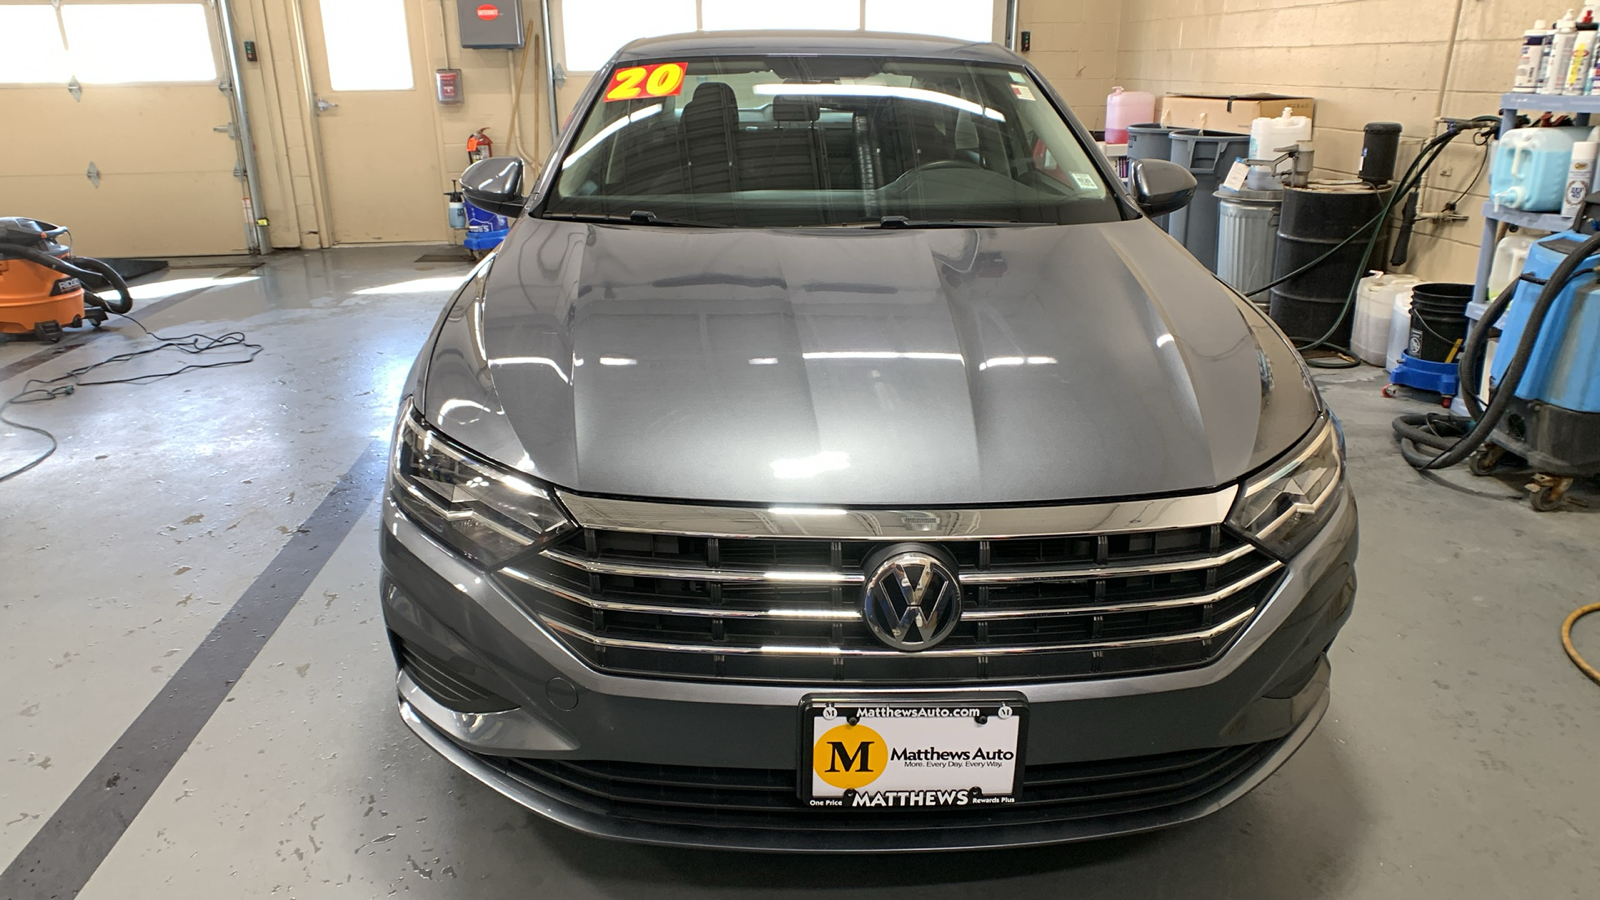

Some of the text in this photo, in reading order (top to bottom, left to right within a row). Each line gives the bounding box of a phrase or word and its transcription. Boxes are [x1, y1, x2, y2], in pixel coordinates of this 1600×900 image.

[606, 63, 684, 99] 20
[856, 706, 980, 718] MatthewsAuto.com
[824, 741, 875, 773] M
[890, 746, 1014, 761] Matthews Auto
[926, 761, 947, 769] Every
[965, 761, 986, 769] Every
[852, 790, 969, 807] MATTHEWS
